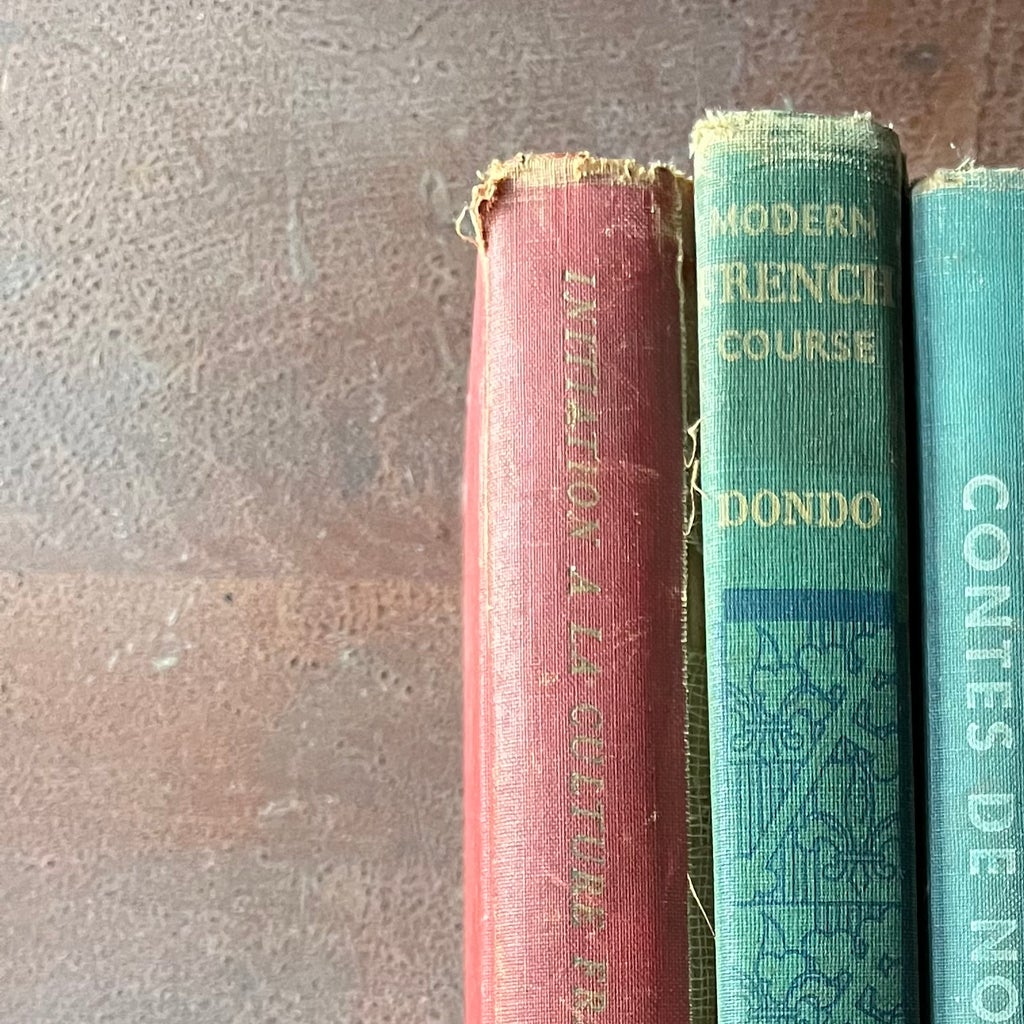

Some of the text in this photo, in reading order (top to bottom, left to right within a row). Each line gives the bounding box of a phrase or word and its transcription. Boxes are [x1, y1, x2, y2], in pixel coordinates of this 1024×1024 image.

[710, 203, 877, 239] MODERN
[719, 329, 877, 365] COURSE
[562, 269, 601, 549] INITIATION
[717, 488, 883, 530] DONDO
[962, 473, 1014, 751] CONTES
[569, 621, 603, 675] LA
[569, 702, 606, 930] CULTURE
[968, 793, 1018, 876] DE
